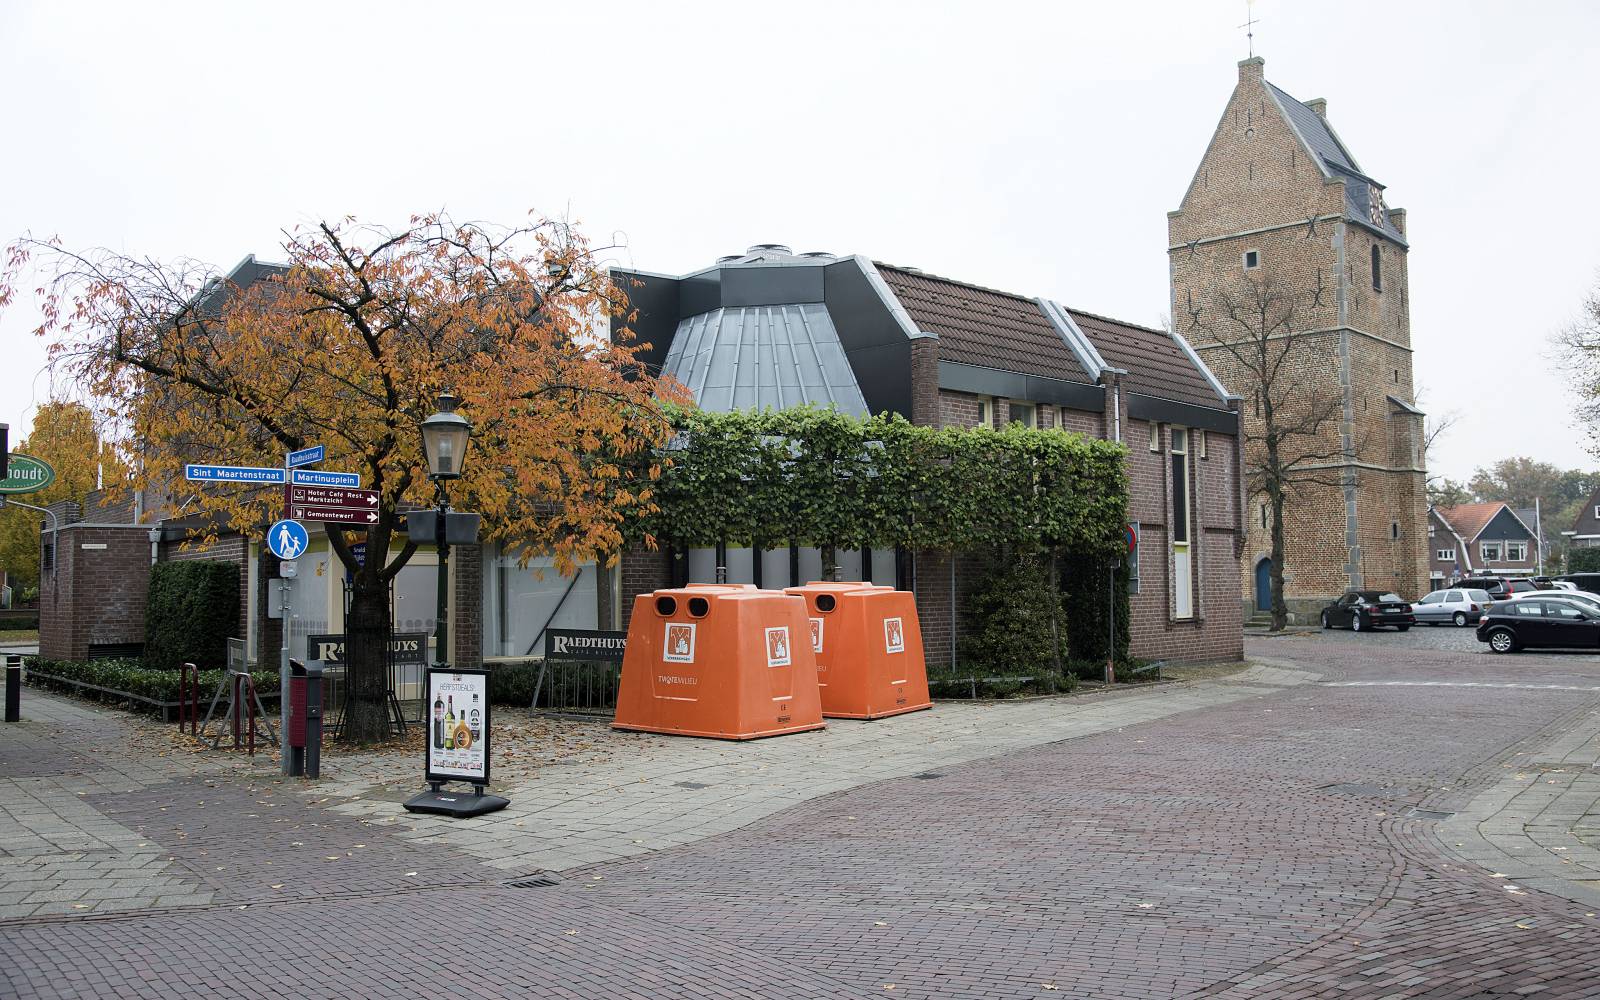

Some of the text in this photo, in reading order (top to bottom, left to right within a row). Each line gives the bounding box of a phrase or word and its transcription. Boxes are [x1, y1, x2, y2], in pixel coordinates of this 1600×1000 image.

[193, 469, 280, 480] Sint Maartenstraat
[297, 474, 355, 485] Martinusplein
[307, 496, 343, 504] Marktzicht
[307, 511, 354, 519] Gemeentewerf
[552, 636, 627, 654] RAEDTHUYS
